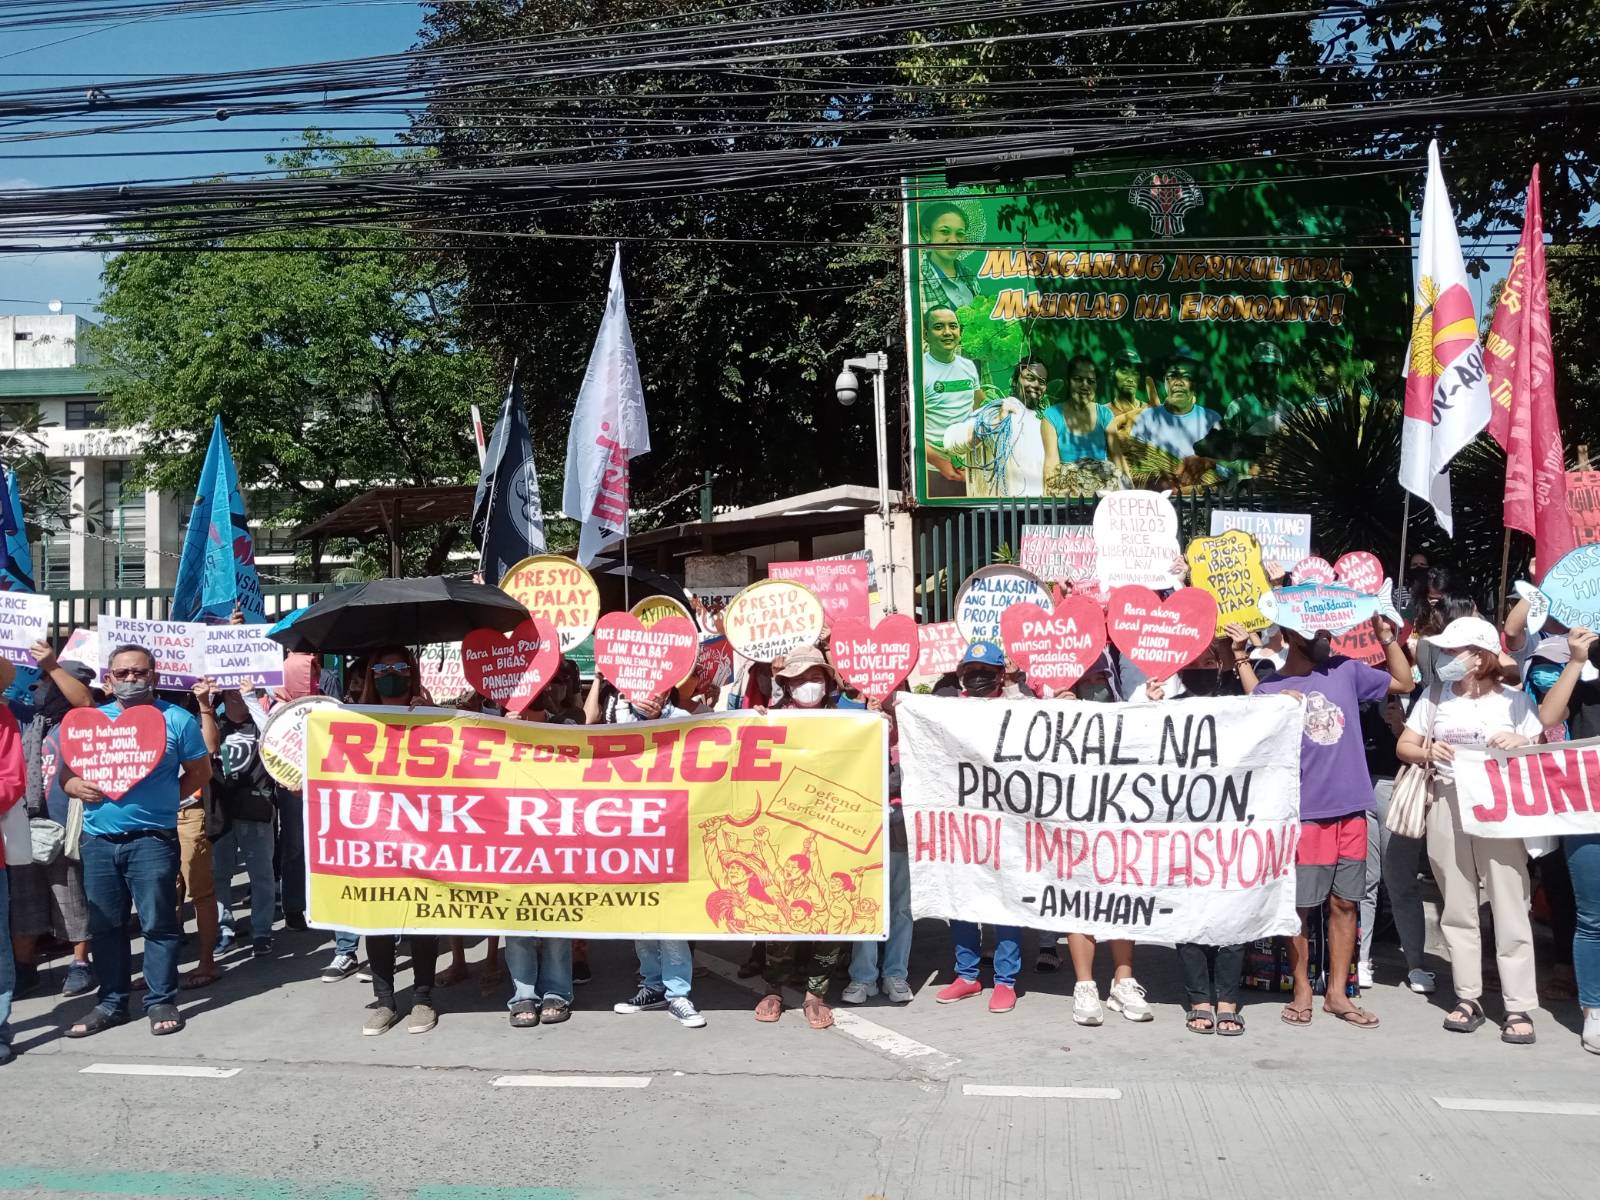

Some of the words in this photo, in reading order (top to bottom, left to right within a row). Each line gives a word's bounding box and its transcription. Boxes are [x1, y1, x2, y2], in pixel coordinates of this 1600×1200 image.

[1134, 294, 1173, 322] NA
[1108, 497, 1166, 518] REPEAL
[1121, 534, 1151, 545] RICE
[513, 568, 582, 589] PRESYO
[970, 578, 1038, 594] PALAKASIN
[1208, 569, 1251, 588] PRESYO
[5, 597, 27, 610] RICE
[534, 589, 592, 607] PALAY
[738, 590, 798, 613] PRESYO
[964, 595, 986, 607] ANG
[733, 612, 756, 627] NG
[762, 601, 808, 622] PALAY
[1123, 602, 1147, 616] Para
[0, 613, 42, 627] ZATION
[115, 620, 164, 634] PRESYO
[166, 624, 186, 635] NG
[749, 613, 816, 642] ITAAS!
[1022, 617, 1078, 638] PAASA
[153, 636, 195, 648] ITAAS!
[207, 630, 235, 640] JUNK
[237, 628, 261, 639] RICE
[596, 628, 615, 640] RICE
[616, 629, 693, 648] LIBERALIZATION
[1138, 635, 1170, 649] HINDI
[607, 643, 629, 654] LAW
[631, 643, 646, 657] KA
[835, 641, 850, 656] Di
[852, 638, 878, 654] bale
[881, 642, 910, 660] nang
[1010, 638, 1052, 653] minsan
[1055, 633, 1092, 650] JOWA
[166, 649, 186, 660] NG
[465, 648, 489, 661] Para
[853, 655, 909, 670] LOVELIFE,
[1028, 650, 1077, 664] madalas
[1130, 647, 1188, 664] PRIORITY!
[155, 660, 192, 673] BABA!
[220, 659, 250, 668] LAW!
[482, 665, 494, 673] na
[660, 662, 673, 671] MO
[1029, 662, 1085, 678] GOBYERNO
[650, 669, 663, 680] NG
[871, 670, 895, 684] lang
[871, 682, 889, 695] RICE
[67, 727, 93, 742] Kung
[96, 725, 138, 738] hahanap
[993, 709, 1139, 766] LOKAL
[1158, 714, 1219, 769] NA
[70, 754, 99, 768] dapat
[99, 750, 157, 765] COMPETENT!
[320, 721, 507, 780] RISE
[509, 742, 581, 764] FOR
[582, 725, 788, 783] RICE
[82, 767, 113, 781] HINDI
[804, 784, 862, 813] Defend
[958, 762, 1255, 827] PRODUKSYON,
[317, 788, 486, 836] JUNK
[504, 796, 668, 838] RICE
[813, 799, 837, 814] PH
[776, 796, 867, 839] Agriculture!
[317, 837, 675, 875] LIBERALIZATION!
[914, 810, 1002, 871] HINDI
[1025, 820, 1297, 889] IMPORTASYON!
[341, 885, 429, 903] AMIHAN
[450, 888, 499, 905] KMP
[519, 891, 660, 908] ANAKPAWIS
[416, 903, 509, 921] BANTAY
[515, 907, 584, 922] BIGAS
